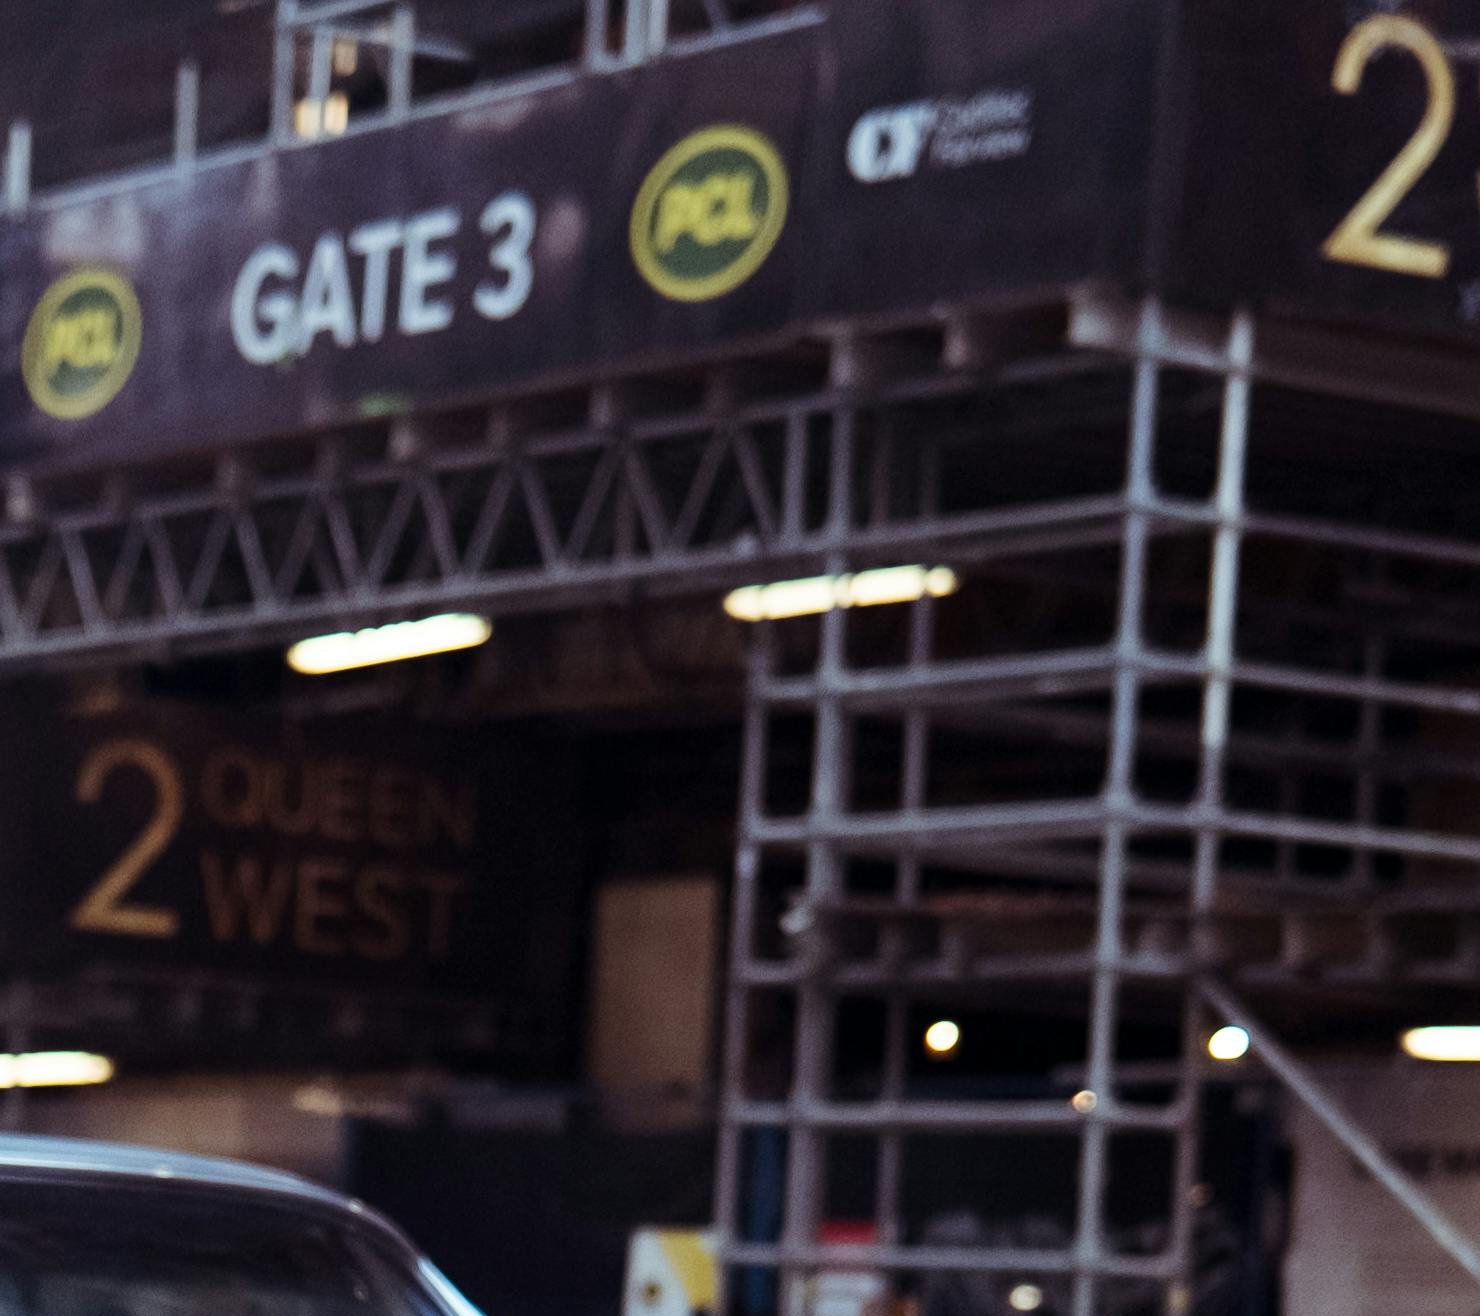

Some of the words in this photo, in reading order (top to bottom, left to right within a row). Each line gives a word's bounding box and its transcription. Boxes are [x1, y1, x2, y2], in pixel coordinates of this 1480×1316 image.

[1321, 12, 1456, 280] 2
[230, 206, 462, 366] GATE
[472, 189, 537, 322] 3
[70, 738, 185, 938] 2
[198, 744, 478, 848] QUEEN
[196, 846, 466, 962] WEST
